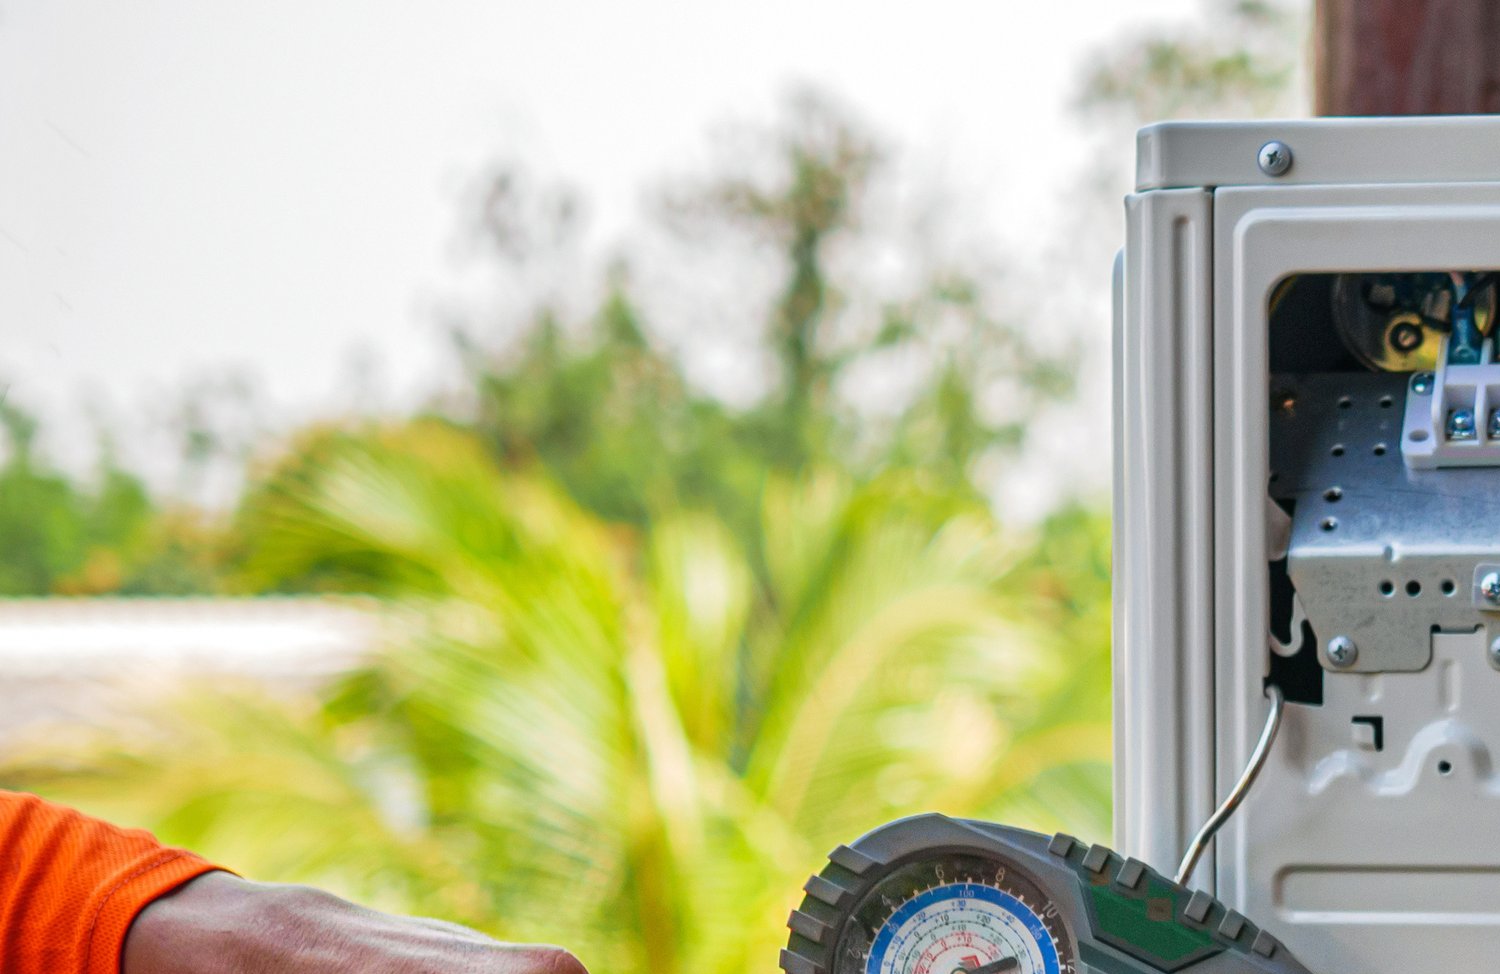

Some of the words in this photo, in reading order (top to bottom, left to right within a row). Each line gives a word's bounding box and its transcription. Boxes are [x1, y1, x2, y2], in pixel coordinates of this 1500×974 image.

[935, 864, 945, 879] 6
[996, 866, 1005, 881] 8
[959, 890, 974, 898] 100
[881, 894, 893, 907] 4
[1042, 900, 1058, 919] 10
[934, 914, 948, 923] +10
[976, 913, 991, 923] +20
[958, 936, 972, 944] +10
